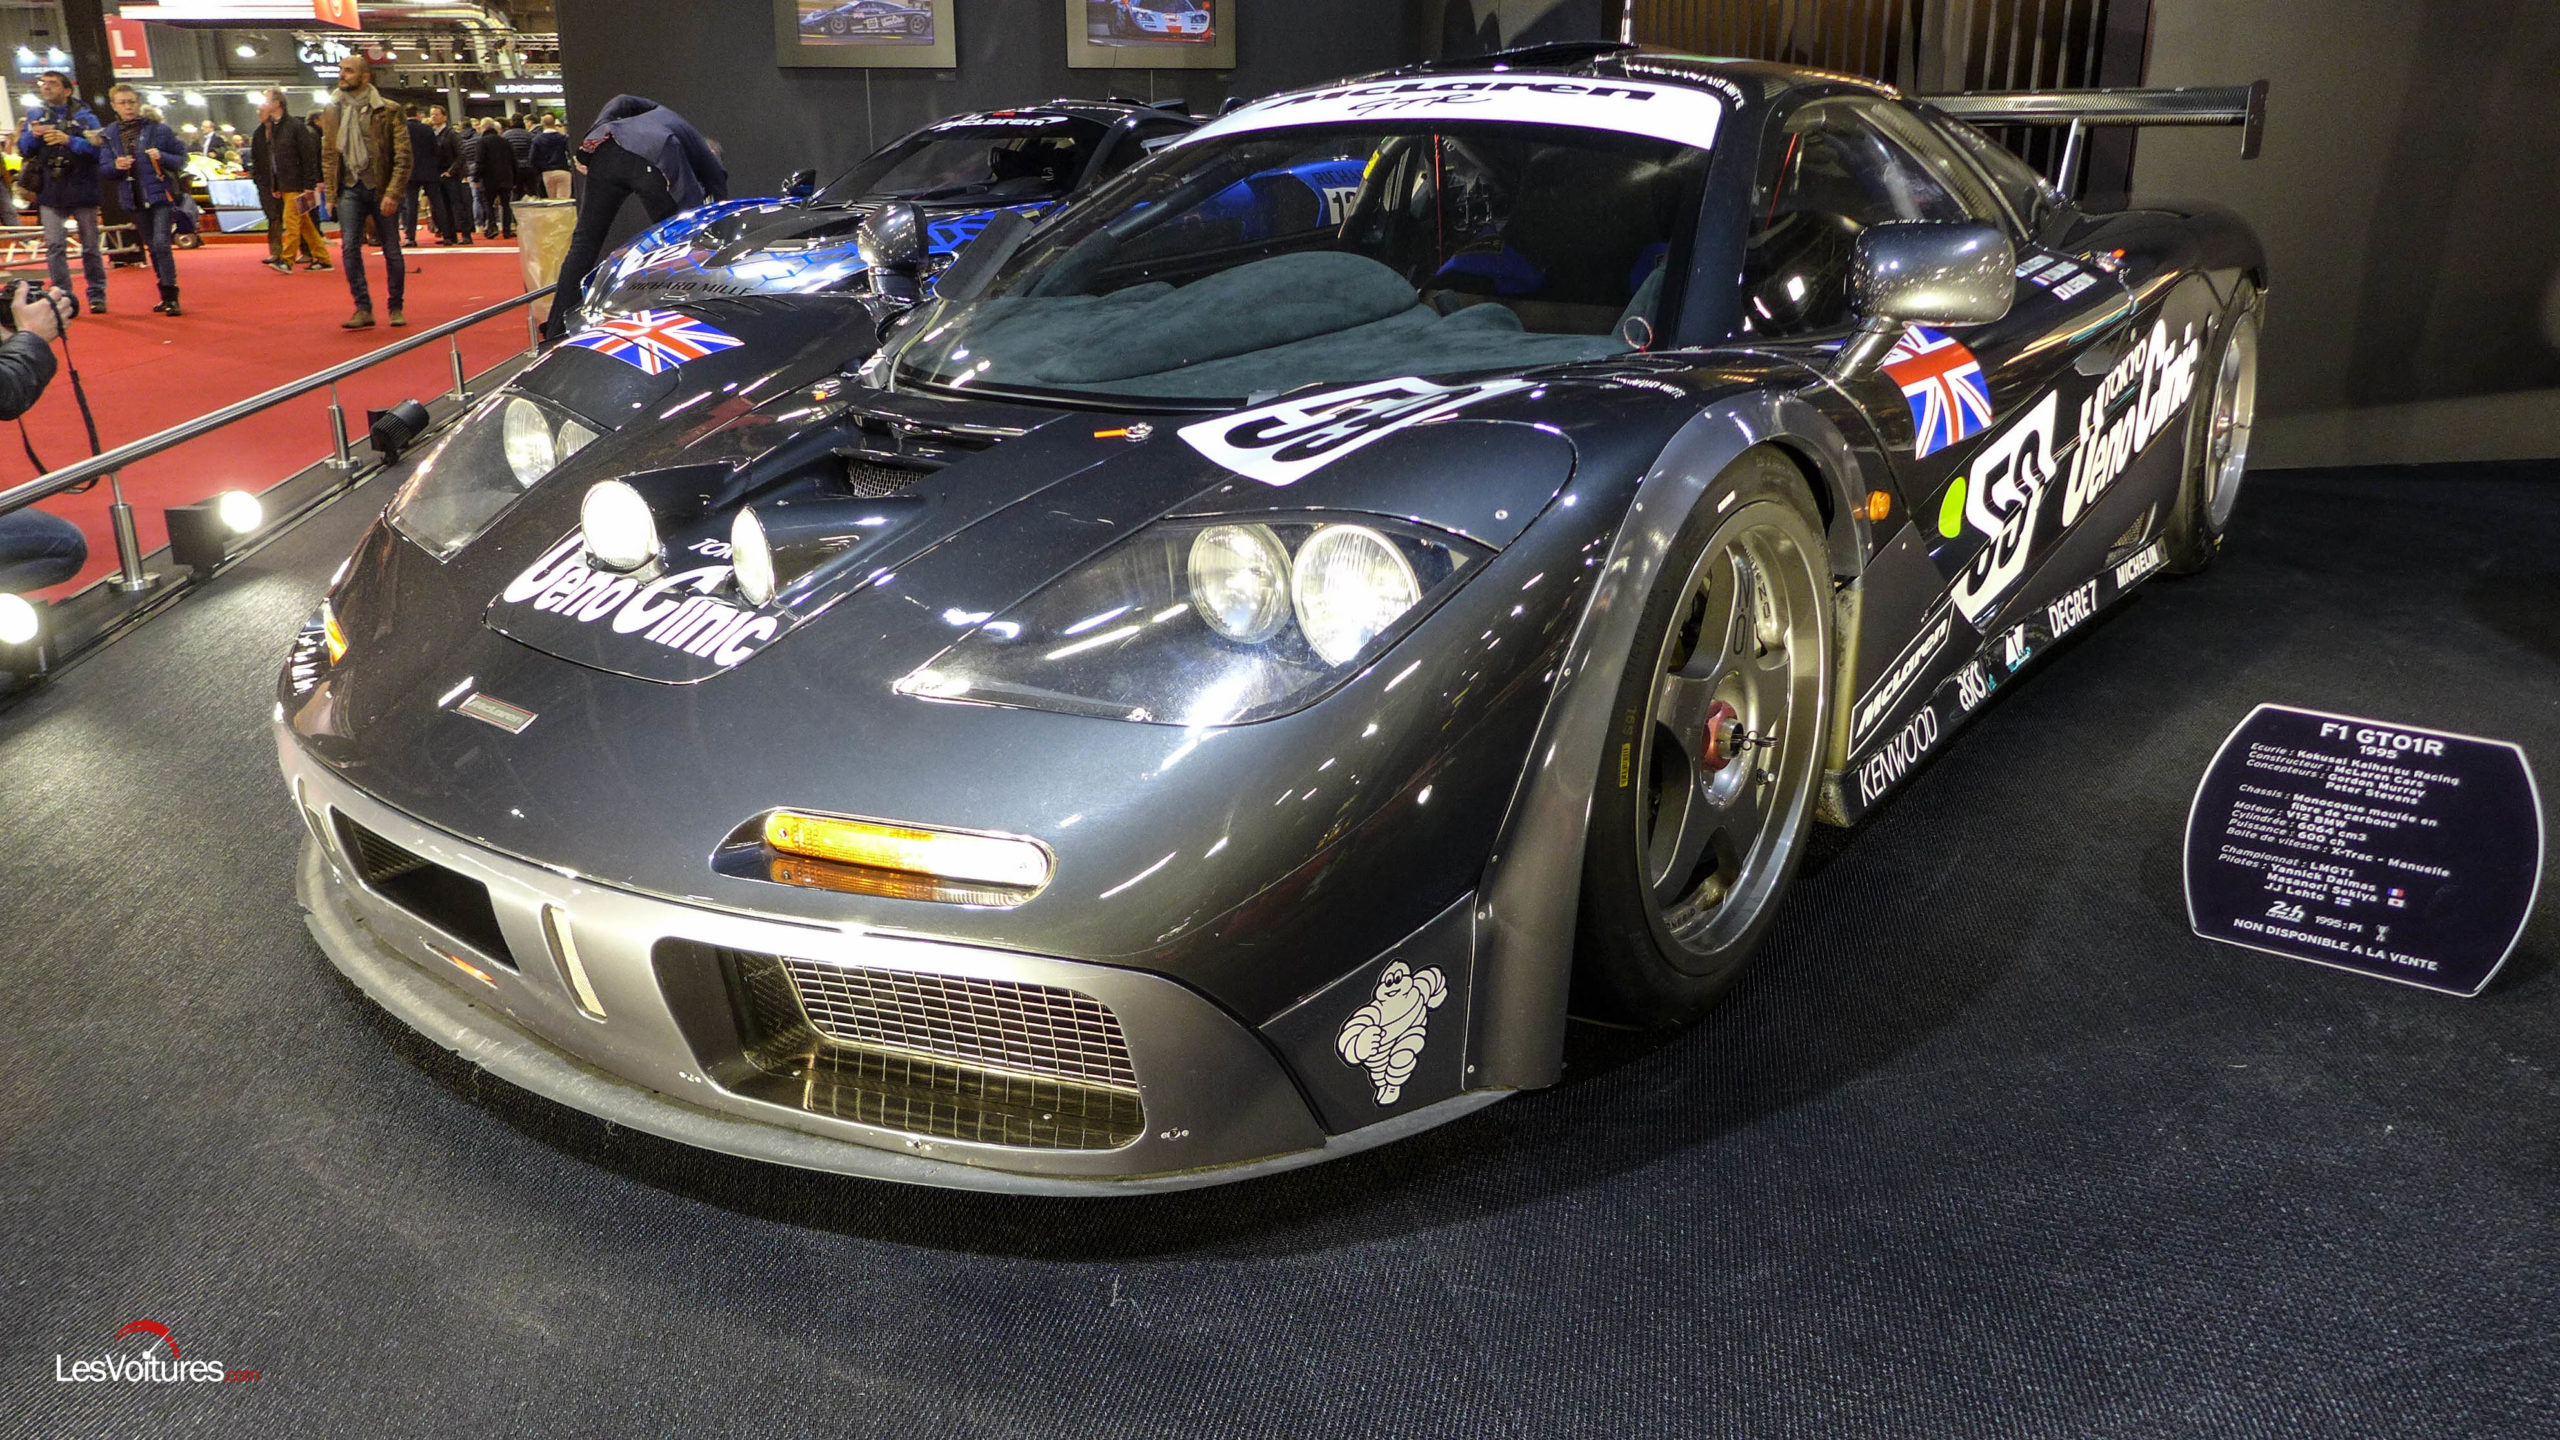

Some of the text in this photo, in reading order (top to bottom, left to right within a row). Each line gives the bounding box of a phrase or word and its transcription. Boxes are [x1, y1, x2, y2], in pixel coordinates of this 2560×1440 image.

[111, 30, 137, 57] L
[1261, 81, 1656, 112] McLaren
[698, 283, 754, 297] MILLE
[2115, 544, 2161, 590] MICHELIN
[1855, 617, 1949, 740] McLaren
[2320, 722, 2349, 740] F1
[1858, 705, 1939, 808] KENWOOD
[2250, 742, 2288, 755] Ecurie
[2297, 750, 2348, 765] Kokusai
[2351, 759, 2411, 776] Kaihatsu
[2413, 770, 2460, 786] Racing
[2359, 745, 2398, 759] 1995
[2246, 759, 2318, 778] Concepteurs
[2327, 773, 2374, 787] Gordon
[2378, 781, 2427, 799] Murray
[2248, 750, 2324, 770] Constructeur
[2334, 765, 2390, 781] McLaren
[2393, 775, 2425, 788] Cars
[2239, 784, 2283, 798] Chassis
[2292, 793, 2366, 813] Monocoque
[2420, 818, 2439, 828] en
[2325, 781, 2419, 805] Peter Stevens
[2234, 801, 2276, 815] Moteur
[2287, 810, 2311, 821] V12
[2314, 815, 2348, 828] BMW
[2290, 802, 2398, 829] fibre de carbone
[2228, 818, 2288, 836] Puissance
[2297, 831, 2327, 843] 600
[2329, 838, 2346, 847] ch
[2297, 822, 2335, 836] 6064
[2338, 830, 2368, 842] cm3
[2221, 844, 2301, 866] Championnat
[2310, 861, 2355, 878] LMGT1
[2259, 833, 2276, 843] de
[2278, 837, 2321, 852] vitesse
[2330, 847, 2374, 862] X-Trac
[2388, 858, 2451, 878] Manuelle
[2218, 853, 2260, 868] Pilotes
[2271, 863, 2323, 881] Yannick
[2326, 874, 2377, 892] Dalmas
[2266, 872, 2379, 903] Masanori Sekiya
[2264, 882, 2325, 901] JJ Lehto
[2233, 918, 2439, 971] NON DISPONIBLE A LA VENTE
